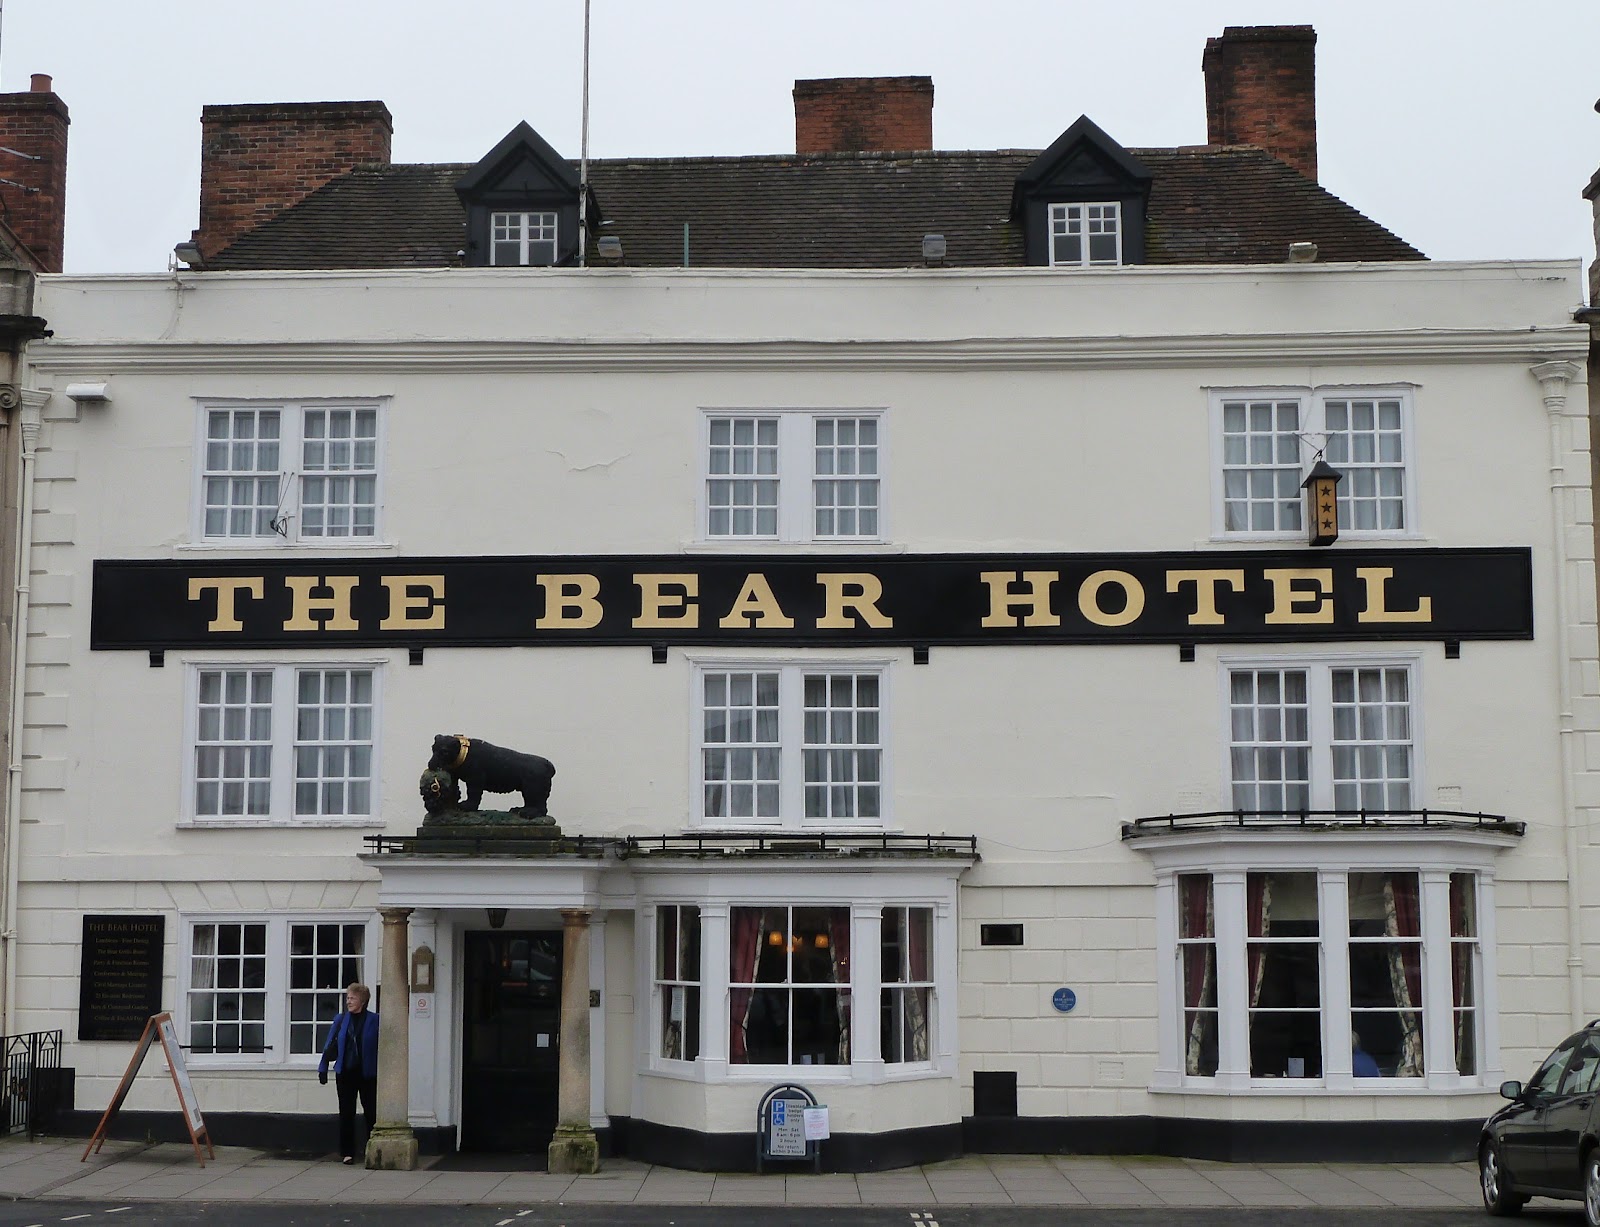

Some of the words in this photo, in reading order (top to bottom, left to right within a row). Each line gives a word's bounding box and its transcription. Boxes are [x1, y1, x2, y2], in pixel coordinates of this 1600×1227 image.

[187, 574, 446, 632] THE
[535, 572, 894, 630] BEAR
[980, 567, 1433, 628] HOTEL
[89, 923, 105, 932] THE
[108, 923, 128, 932] BEAR
[130, 923, 158, 932] HOTEL
[775, 1101, 783, 1112] P
